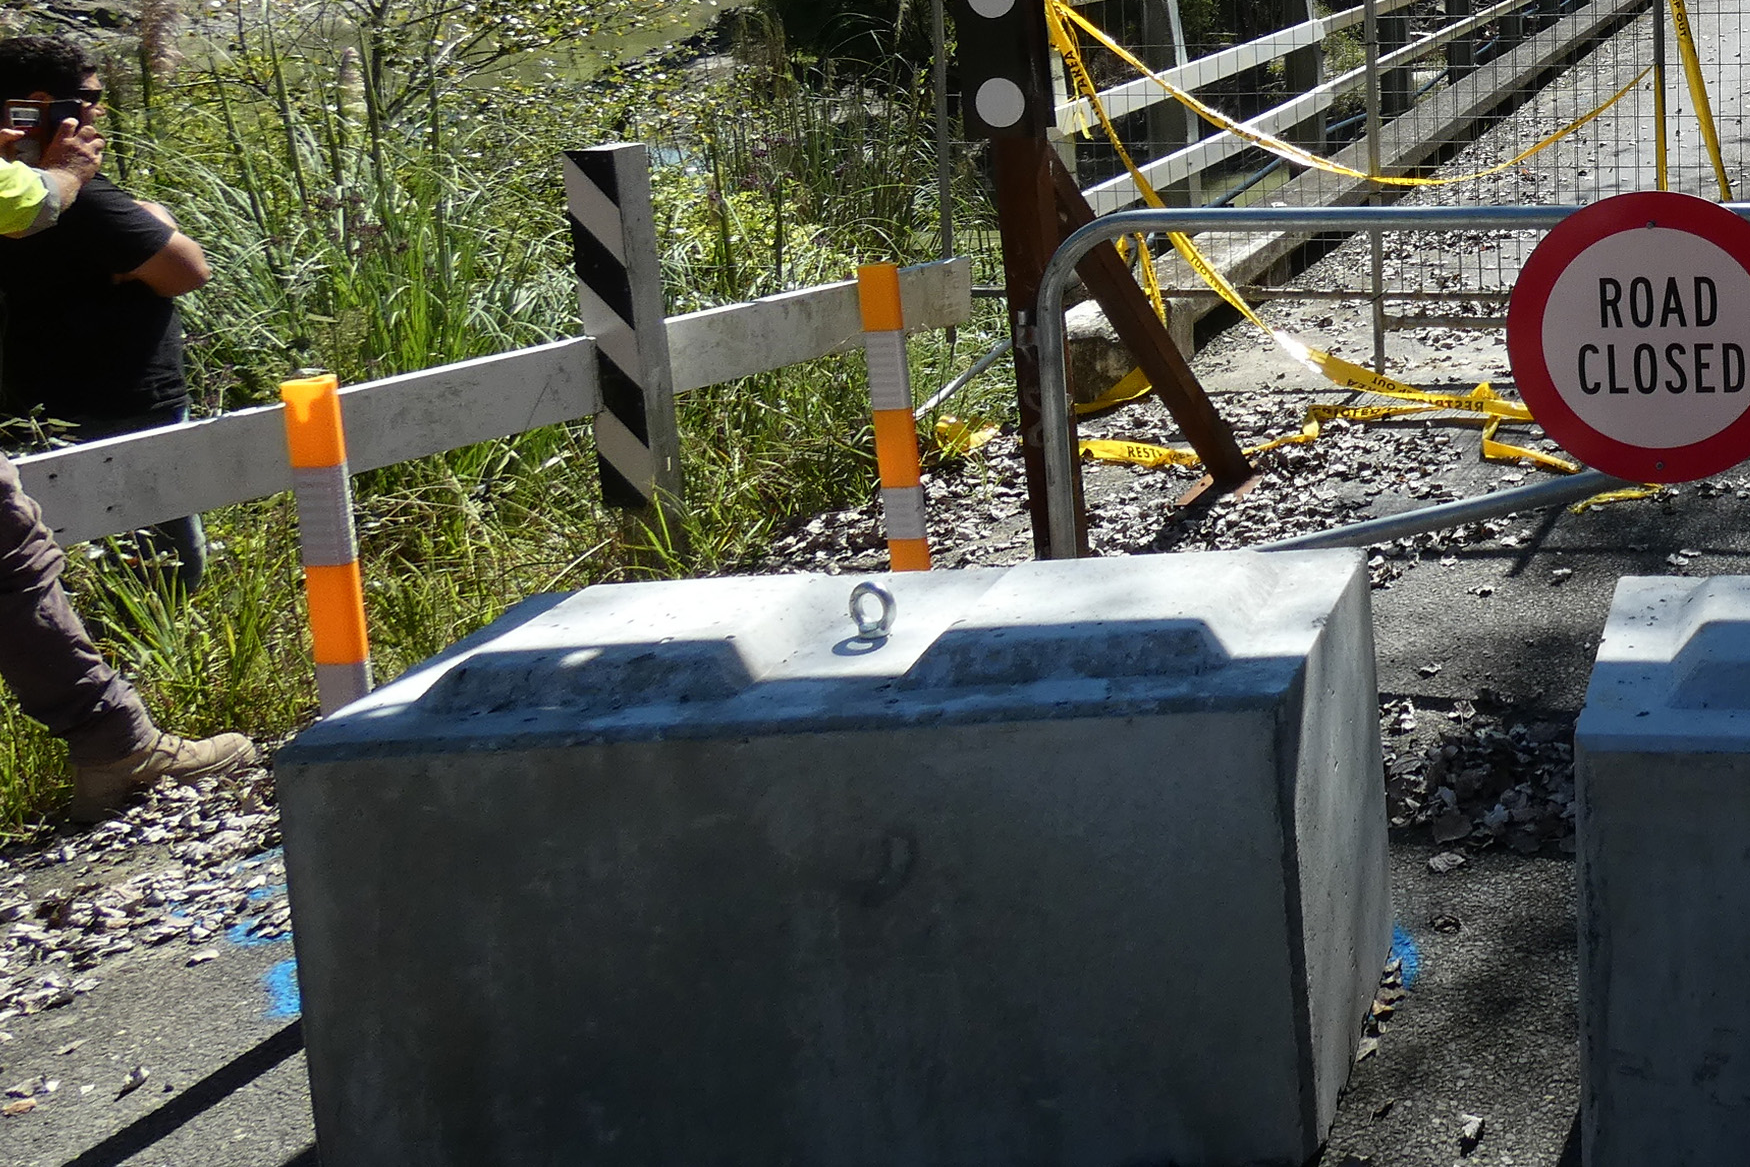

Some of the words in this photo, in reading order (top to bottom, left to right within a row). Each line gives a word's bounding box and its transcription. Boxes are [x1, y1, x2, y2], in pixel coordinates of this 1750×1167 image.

[1676, 13, 1687, 37] OUT
[1599, 277, 1718, 328] ROAD
[1578, 343, 1746, 395] CLOSED
